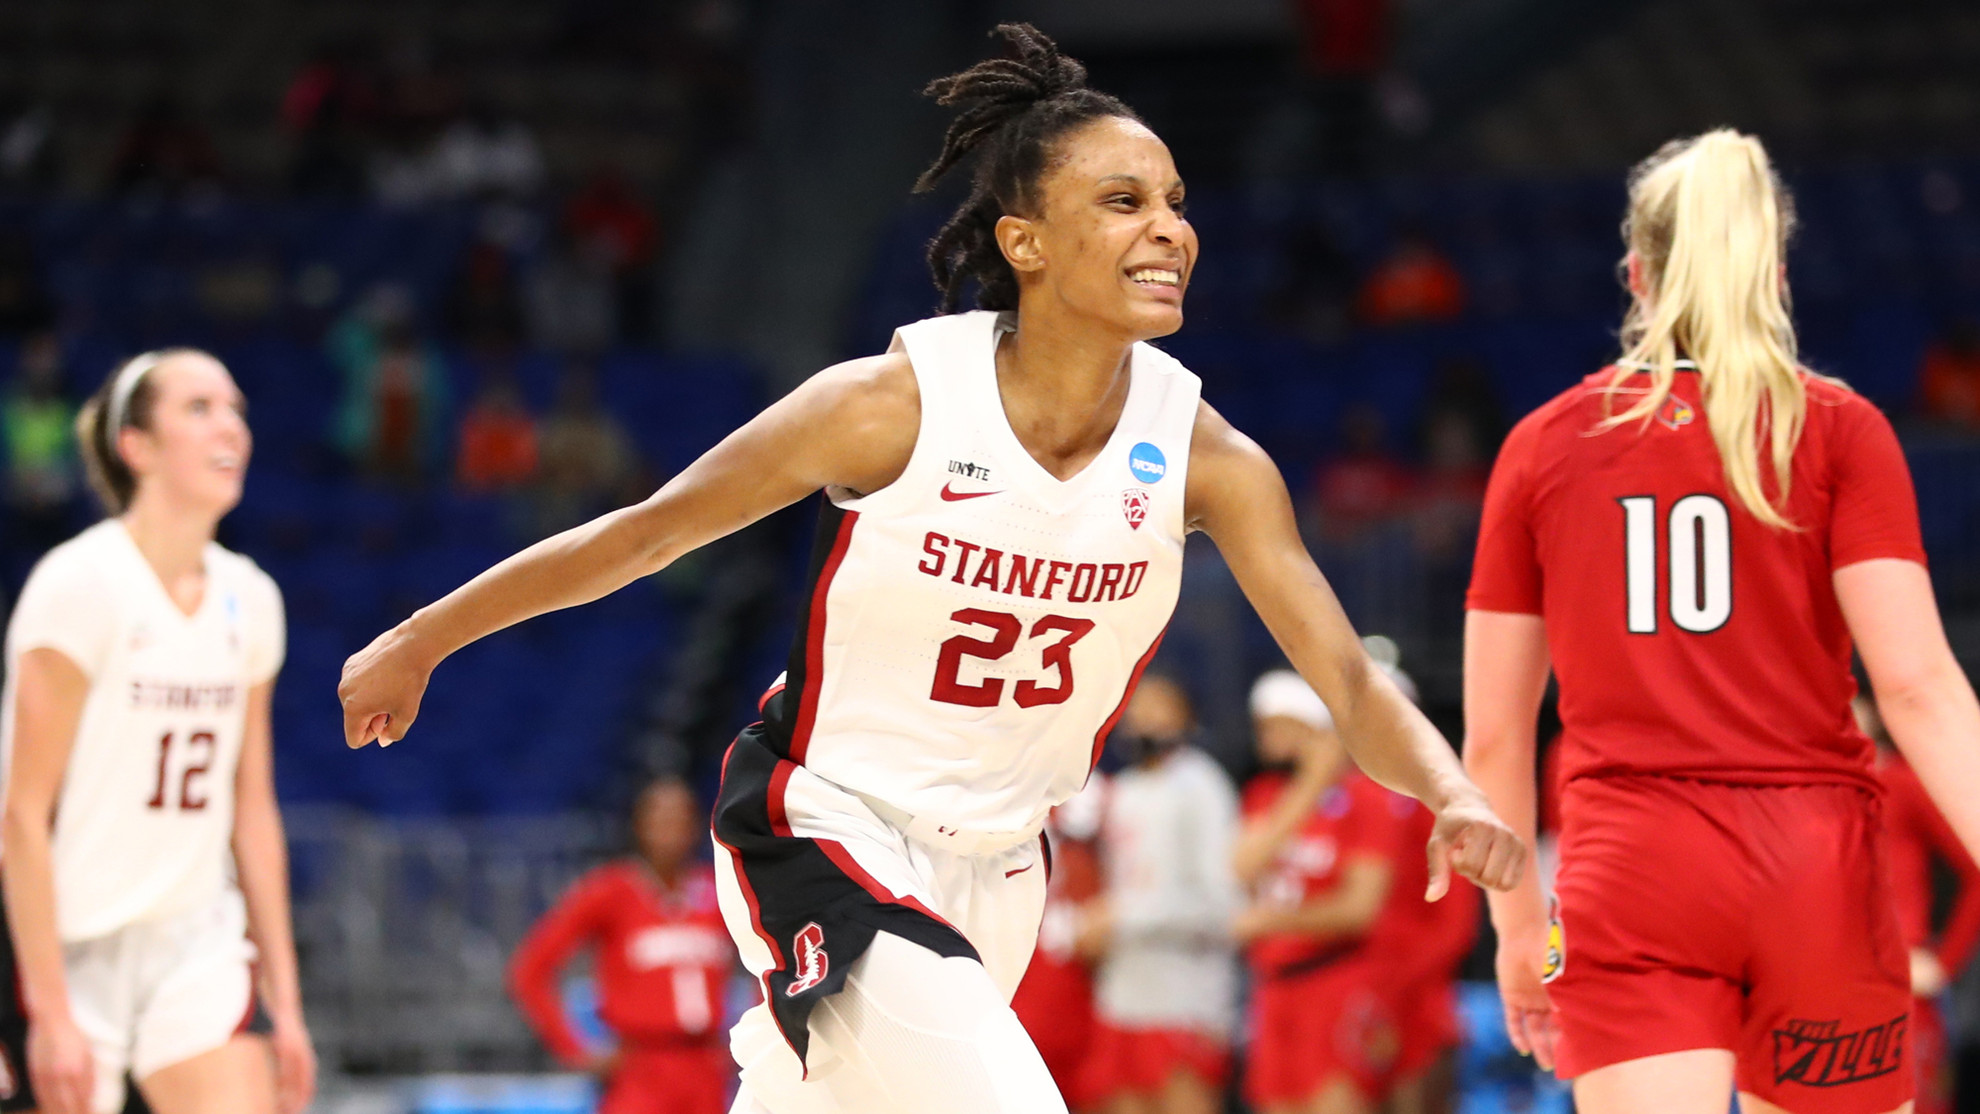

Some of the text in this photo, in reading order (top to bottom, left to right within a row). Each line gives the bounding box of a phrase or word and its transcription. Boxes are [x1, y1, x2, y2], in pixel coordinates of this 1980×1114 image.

[1131, 458, 1164, 475] NCAA
[918, 531, 1149, 603] STANFORD
[1616, 494, 1732, 634] 10
[929, 607, 1094, 709] 23
[147, 730, 216, 810] 12
[1772, 1013, 1908, 1088] VILLE
